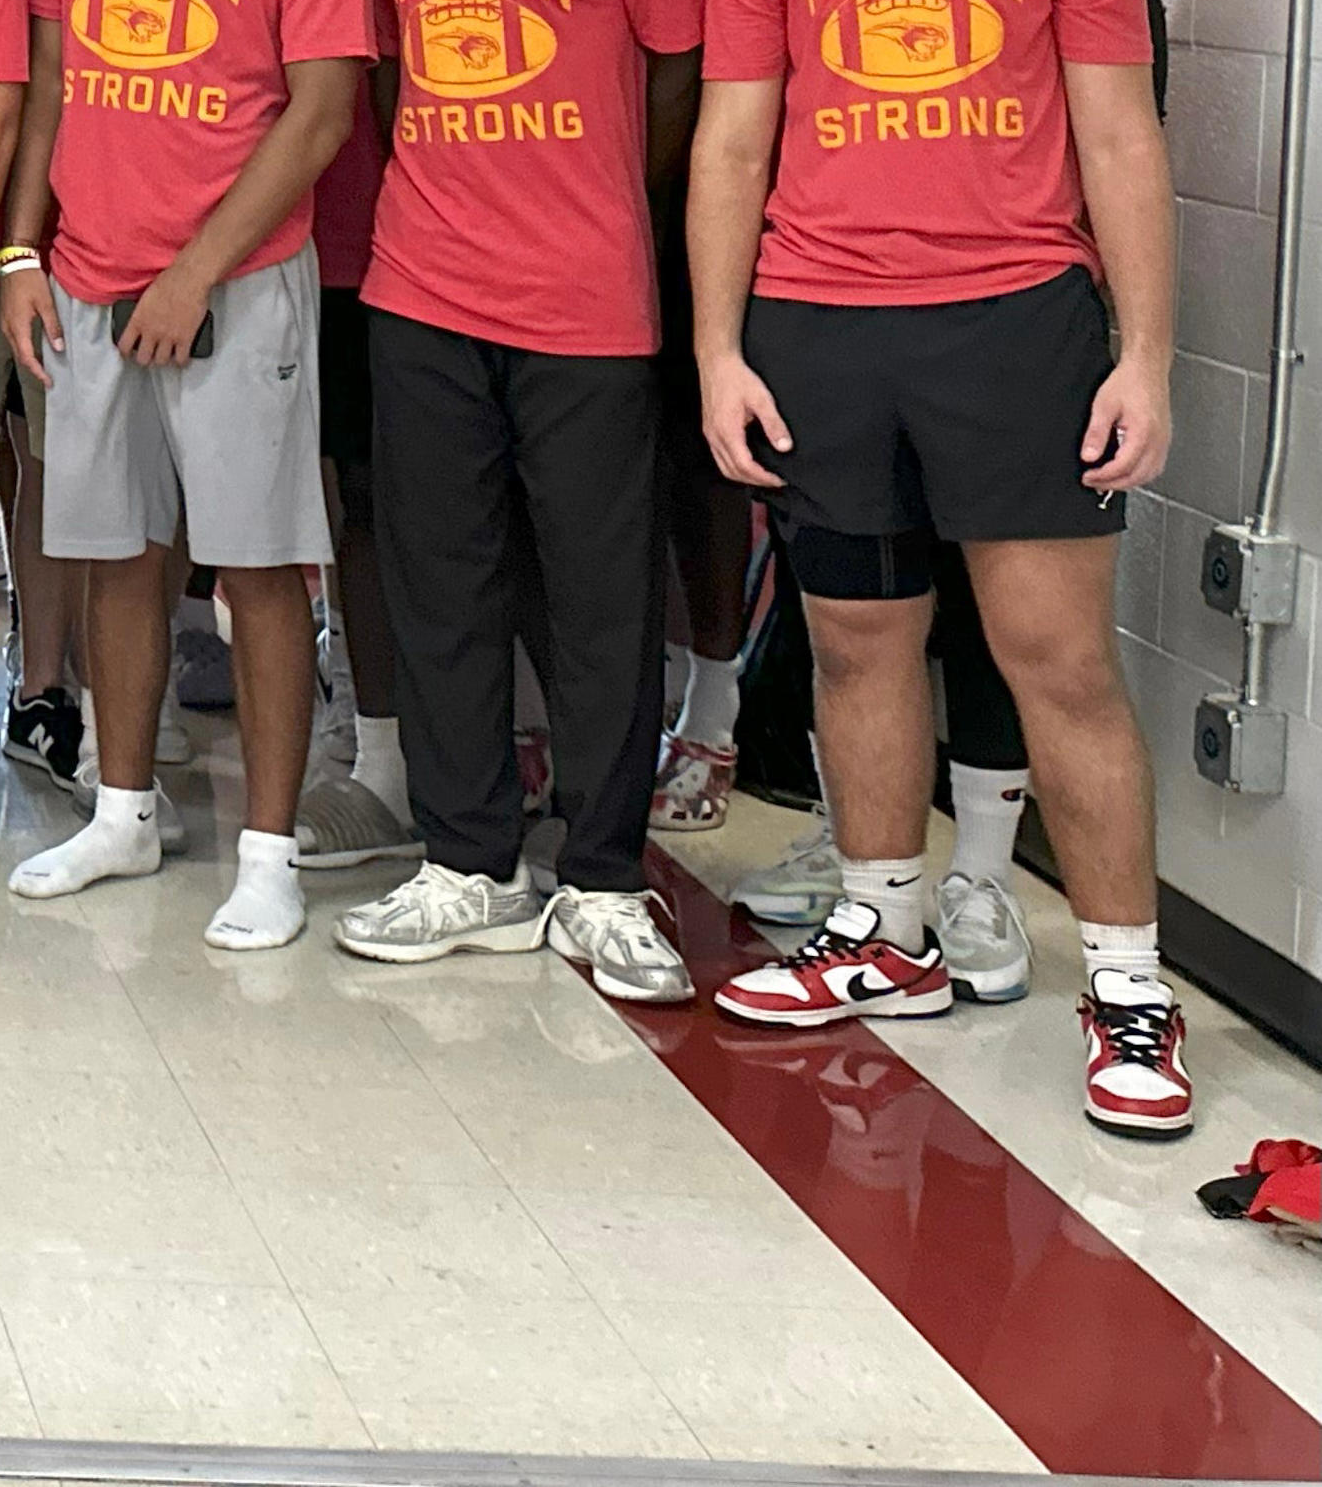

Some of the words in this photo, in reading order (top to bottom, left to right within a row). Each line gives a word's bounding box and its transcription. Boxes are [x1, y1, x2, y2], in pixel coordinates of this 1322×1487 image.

[63, 68, 228, 123] STRONG
[401, 100, 584, 144] STRONG
[814, 96, 1025, 149] STRONG
